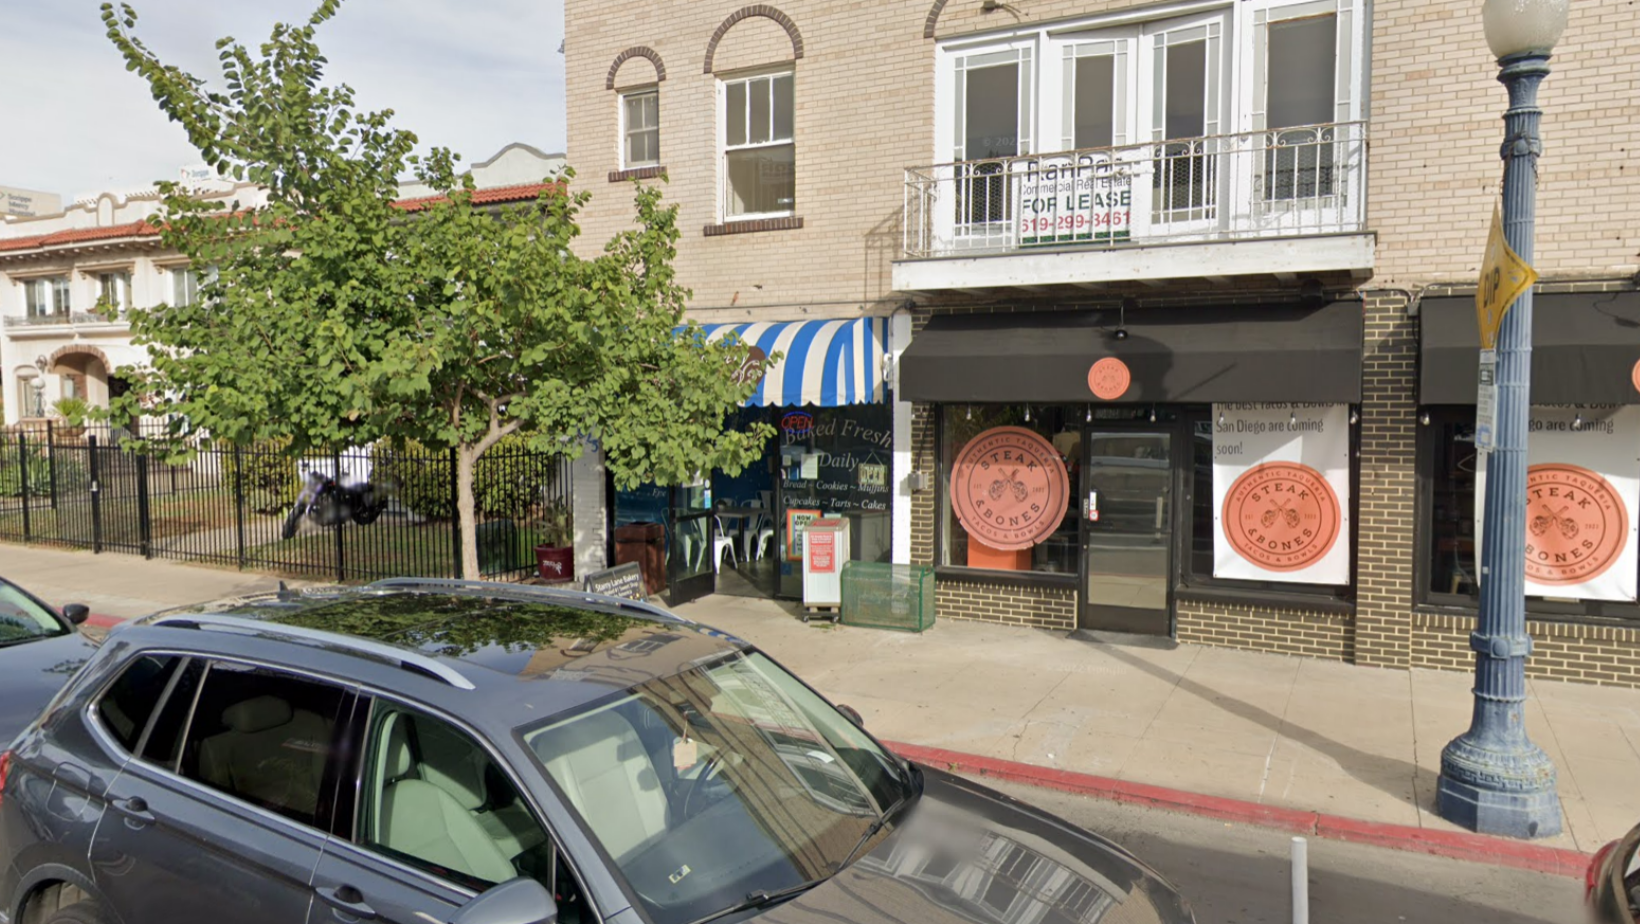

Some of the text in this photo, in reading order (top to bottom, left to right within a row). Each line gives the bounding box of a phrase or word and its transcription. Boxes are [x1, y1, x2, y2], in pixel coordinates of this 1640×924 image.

[1076, 176, 1099, 191] Real
[1101, 175, 1131, 188] Estate
[1022, 190, 1131, 214] FOR LEASE
[1021, 211, 1131, 232] 619-299-3461
[1483, 266, 1500, 309] DIP
[781, 416, 813, 429] OPEN
[785, 417, 892, 448] Baked Fresh
[1216, 418, 1324, 435] San Diego are coming
[1545, 420, 1566, 431] are
[1569, 418, 1614, 434] coming
[966, 436, 1054, 474] AUTHENTIC TAQUERIA
[1216, 441, 1243, 455] soon!
[819, 452, 859, 473] Daily
[981, 450, 1038, 472] STEAK
[783, 480, 807, 489] Bread
[816, 481, 848, 491] Cookies
[1236, 470, 1326, 502] AUTHENTIC TAQUERIA
[1251, 482, 1309, 502] STEAK
[1565, 475, 1612, 511] TAQUERIA
[783, 495, 821, 507] Cupcakes
[830, 498, 851, 508] Tarts
[861, 500, 887, 510] Cakes
[971, 516, 997, 538] TACOS
[1014, 520, 1045, 538] BOWLS
[1244, 542, 1270, 561] TACOS
[1287, 543, 1318, 561] BOWLS
[1561, 556, 1599, 575] BOWLS
